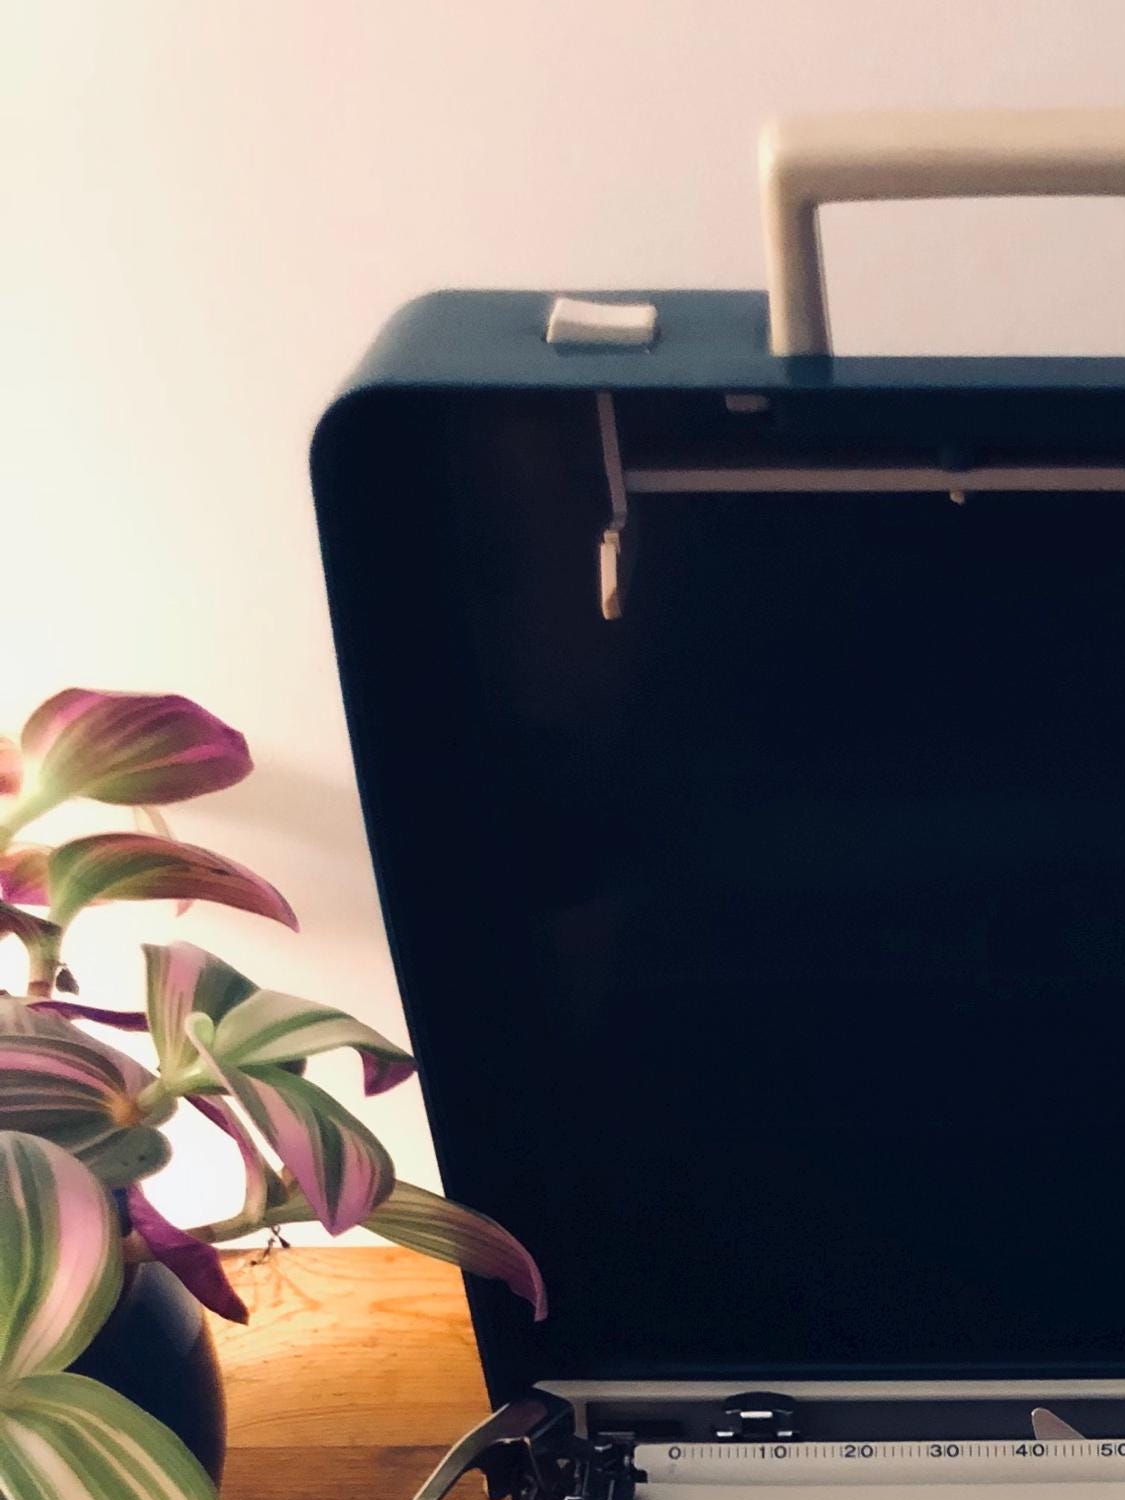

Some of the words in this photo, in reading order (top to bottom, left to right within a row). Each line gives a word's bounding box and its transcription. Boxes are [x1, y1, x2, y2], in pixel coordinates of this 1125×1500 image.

[669, 1445, 682, 1461] 0
[759, 1445, 788, 1460] 10
[844, 1444, 875, 1459] 20
[930, 1444, 960, 1459] 30
[1015, 1443, 1045, 1458] 40
